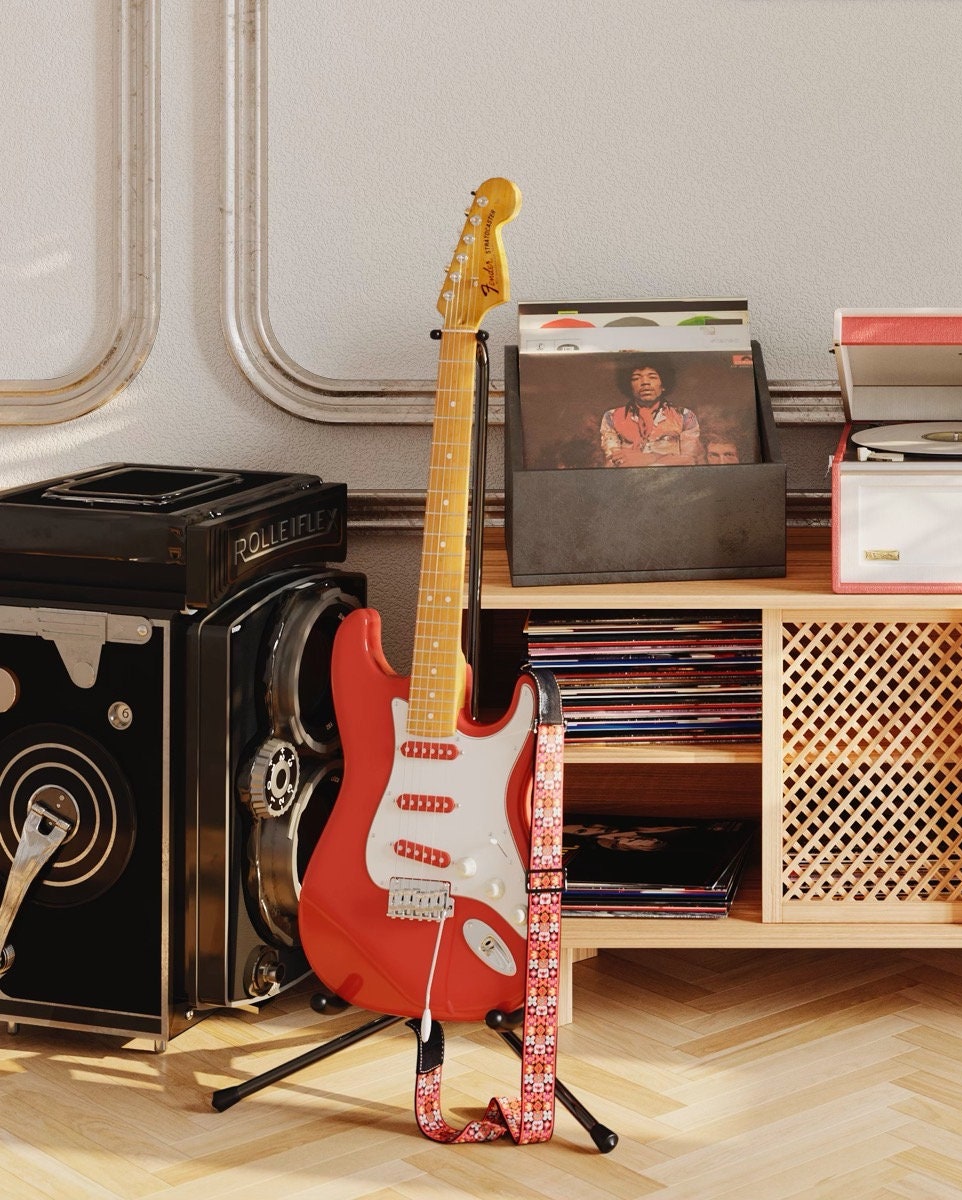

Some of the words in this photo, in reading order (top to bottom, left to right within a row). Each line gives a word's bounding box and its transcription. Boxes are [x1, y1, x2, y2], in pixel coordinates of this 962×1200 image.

[484, 209, 496, 254] STRATOCASTER
[481, 260, 499, 296] Fender
[234, 508, 338, 565] ROLLEIFLEX
